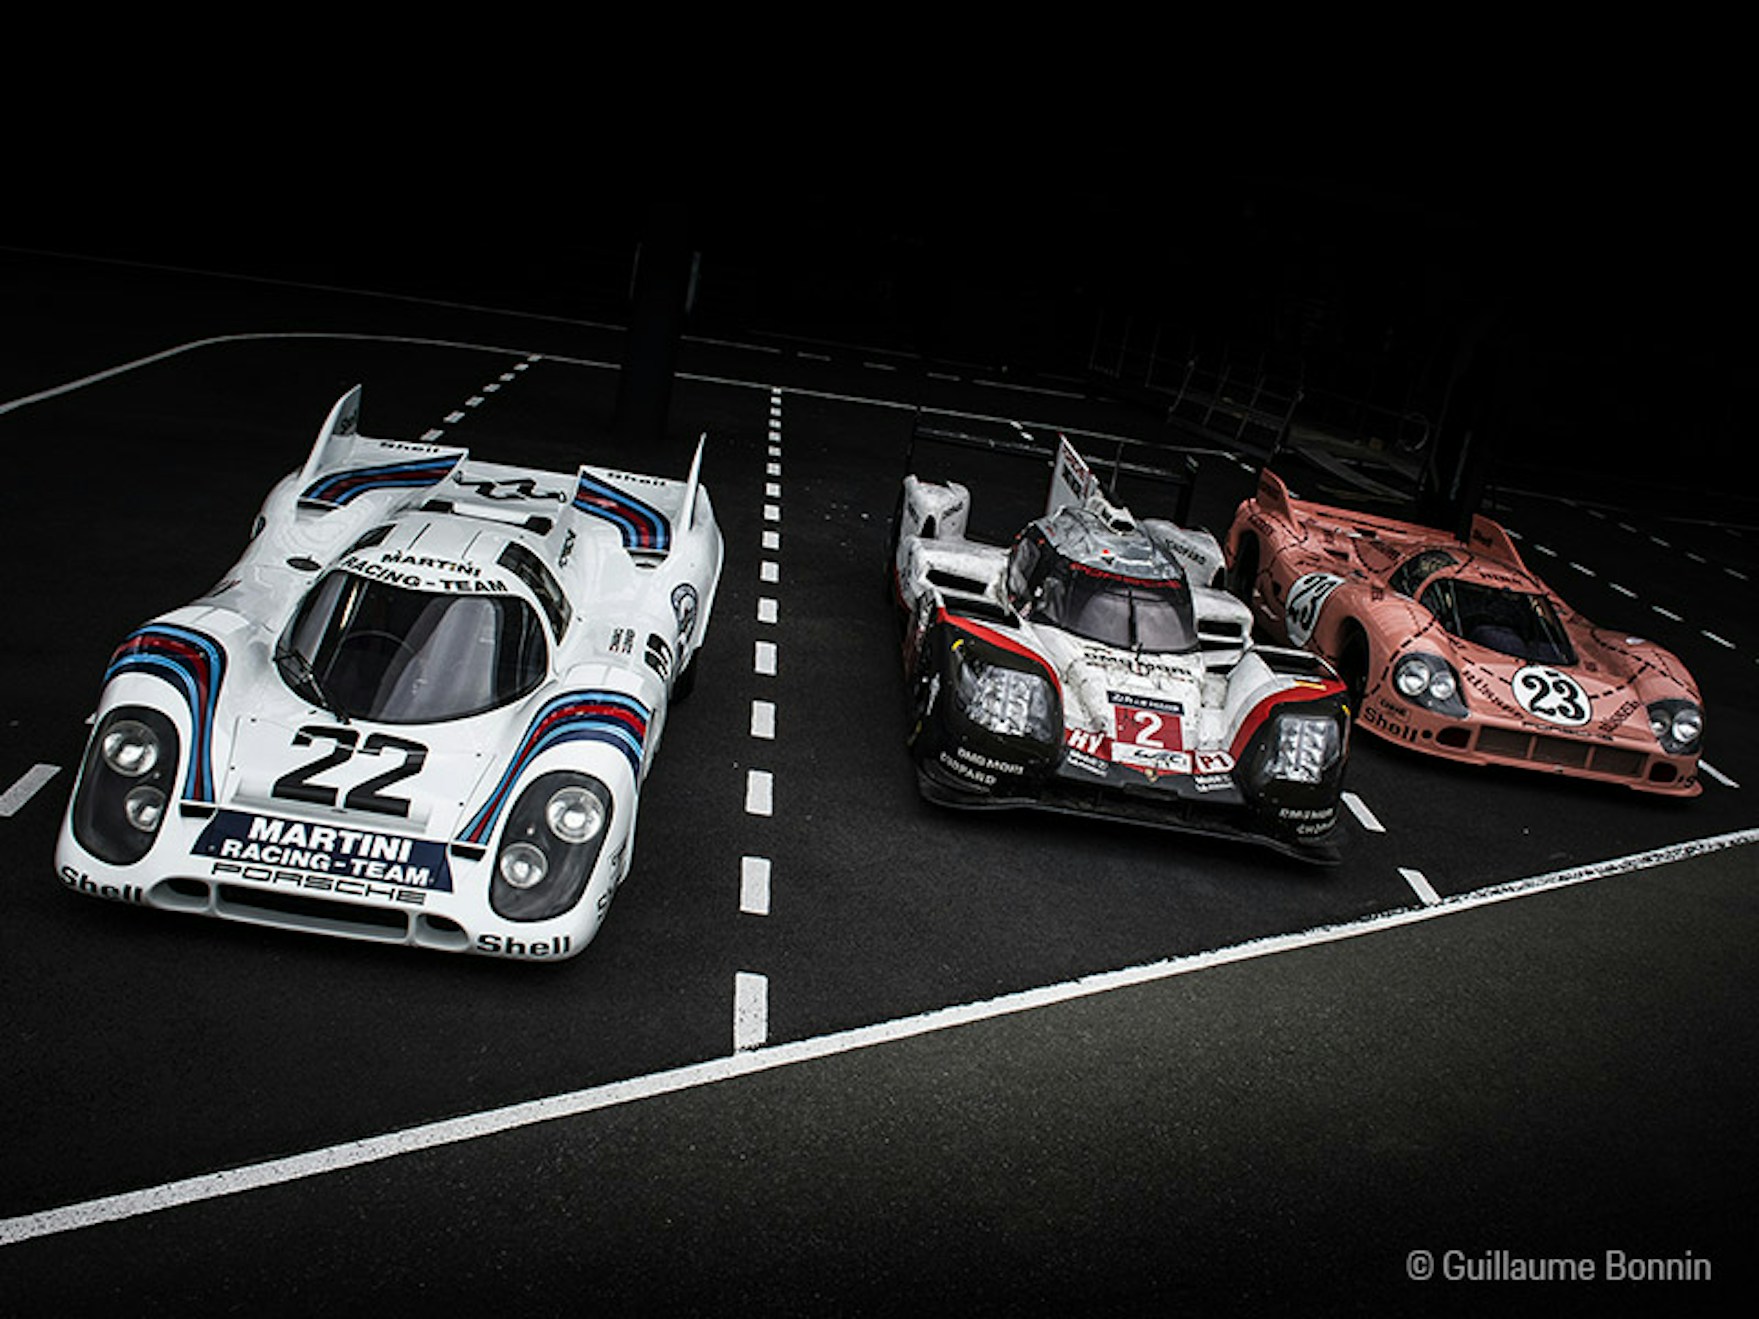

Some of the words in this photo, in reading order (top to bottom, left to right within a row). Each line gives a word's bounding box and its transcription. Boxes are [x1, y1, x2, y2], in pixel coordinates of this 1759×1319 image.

[381, 551, 482, 577] MARTINI
[1521, 674, 1586, 720] 23
[1067, 729, 1105, 755] HY
[1133, 711, 1166, 749] 2
[270, 724, 430, 818] 22
[247, 815, 414, 864] MARTINI
[58, 865, 144, 902] Shell
[210, 861, 429, 906] PORSCHE
[476, 933, 571, 956] Shell
